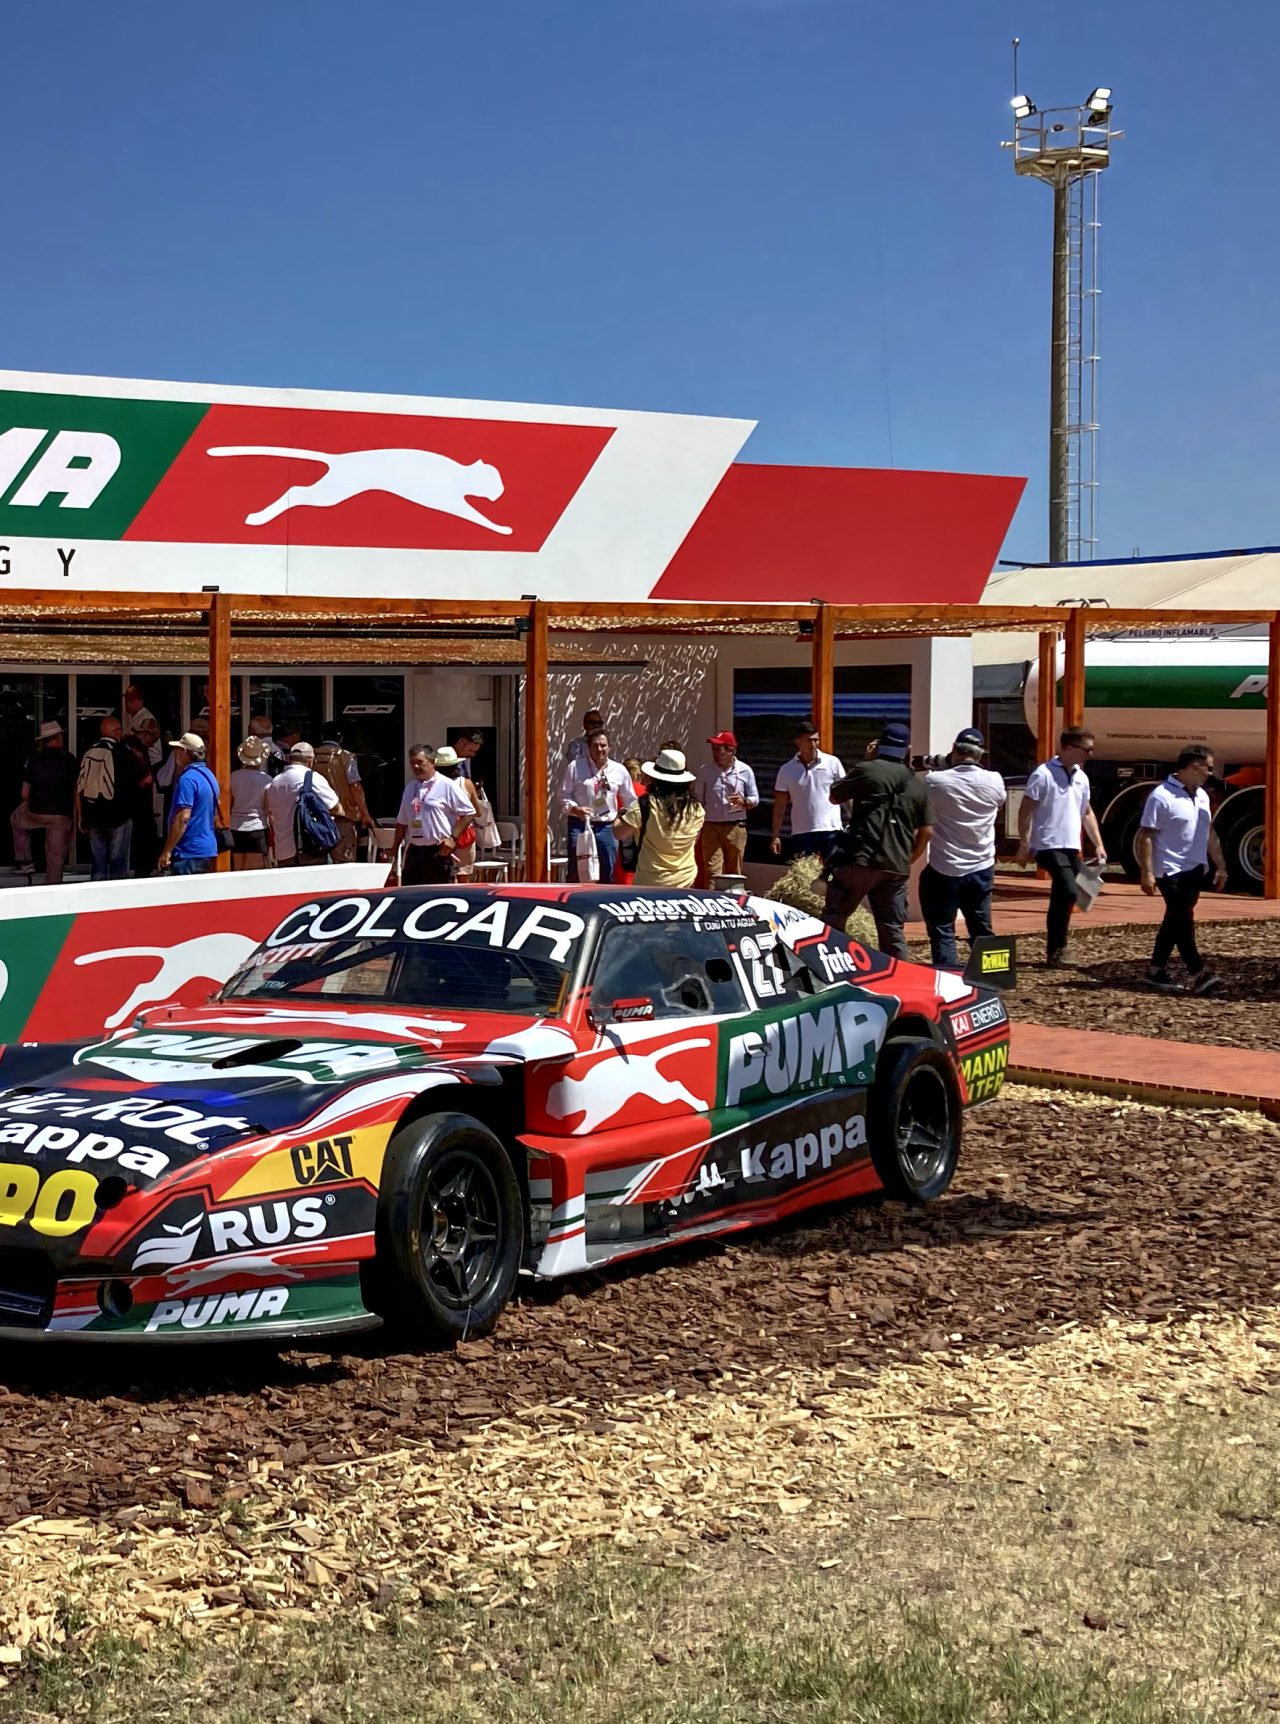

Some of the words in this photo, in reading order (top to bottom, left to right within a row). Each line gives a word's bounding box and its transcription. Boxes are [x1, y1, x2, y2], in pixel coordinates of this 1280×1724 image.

[1128, 628, 1162, 637] PELIGRO
[1163, 627, 1215, 637] INFLAMABLE
[1229, 675, 1269, 698] P
[266, 897, 585, 963] COLCAR
[599, 894, 748, 932] waterplast
[614, 1004, 653, 1018] PUMA
[970, 1002, 1003, 1028] ENERGY
[725, 1001, 888, 1107] PUMA
[961, 1045, 1008, 1082] MANN
[290, 1136, 354, 1185] CAT
[740, 1114, 868, 1183] Kappa
[144, 1285, 289, 1333] PUMA
